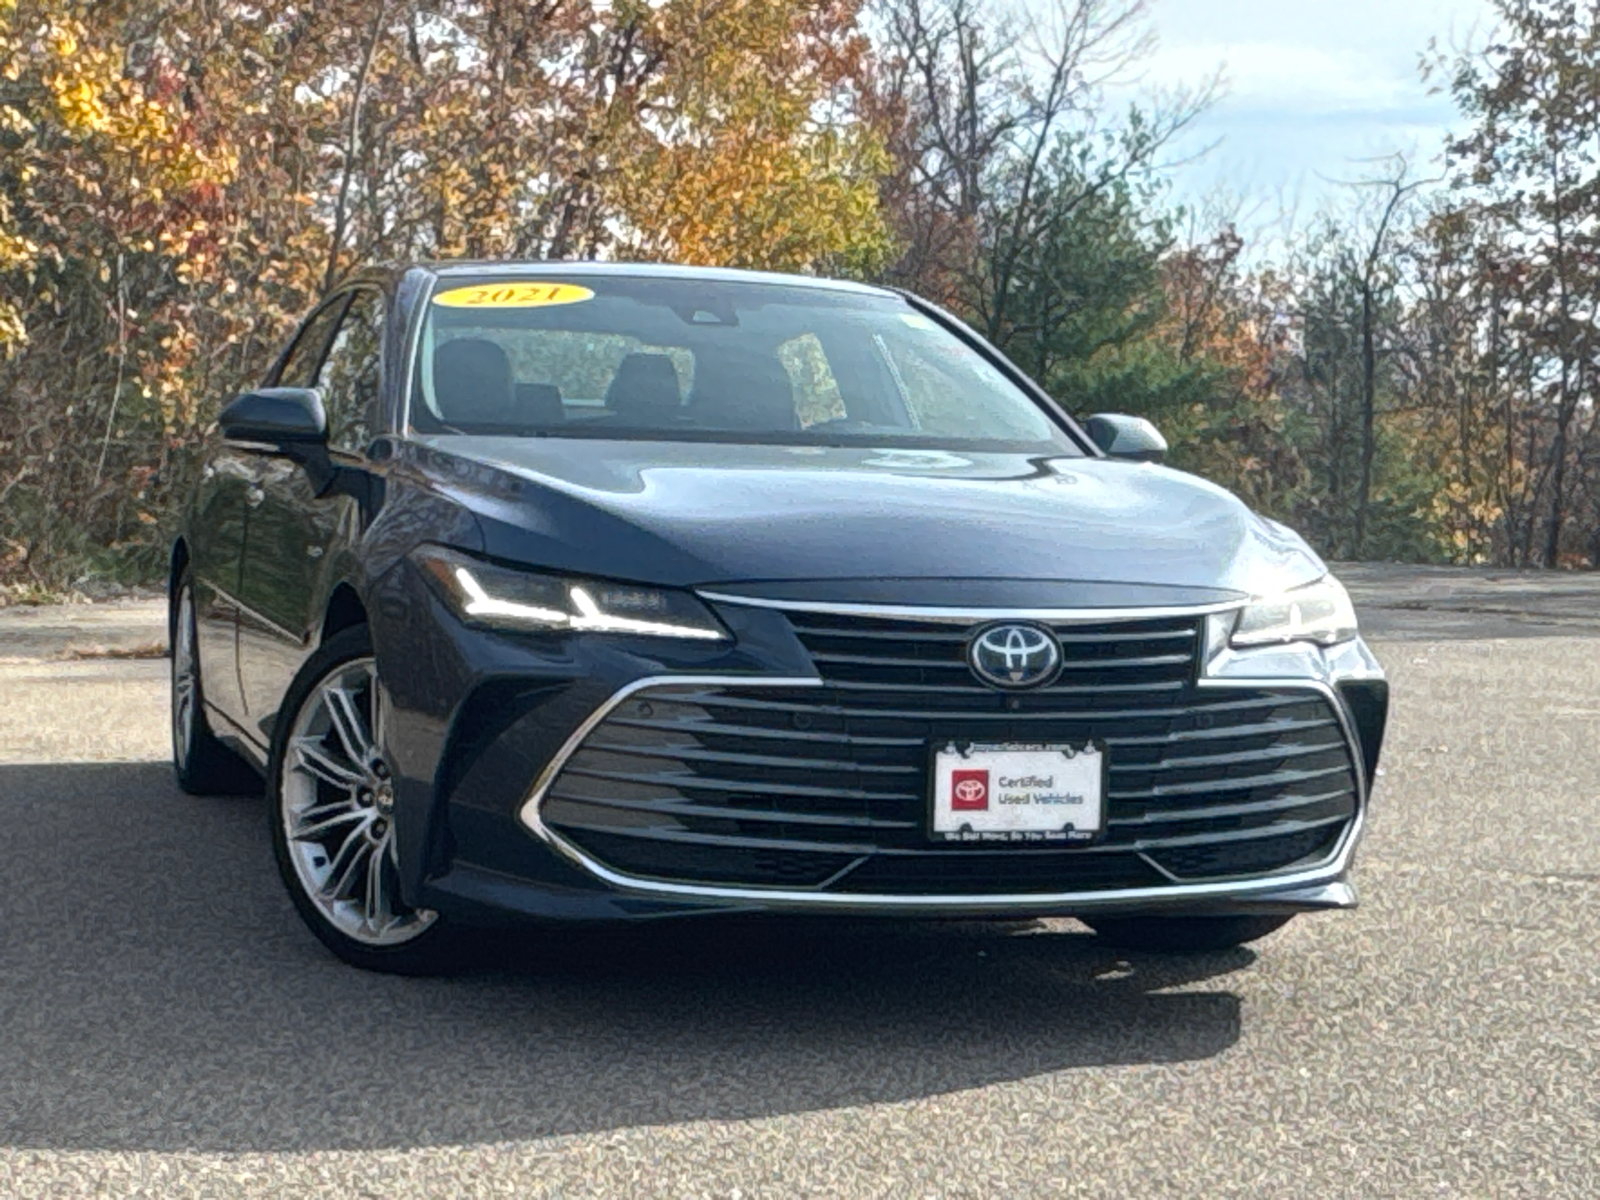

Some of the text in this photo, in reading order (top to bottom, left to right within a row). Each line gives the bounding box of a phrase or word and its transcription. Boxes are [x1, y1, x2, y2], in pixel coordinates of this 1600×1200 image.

[466, 287, 560, 305] 2021
[998, 775, 1054, 788] Certified
[998, 793, 1084, 805] Used Vehicles
